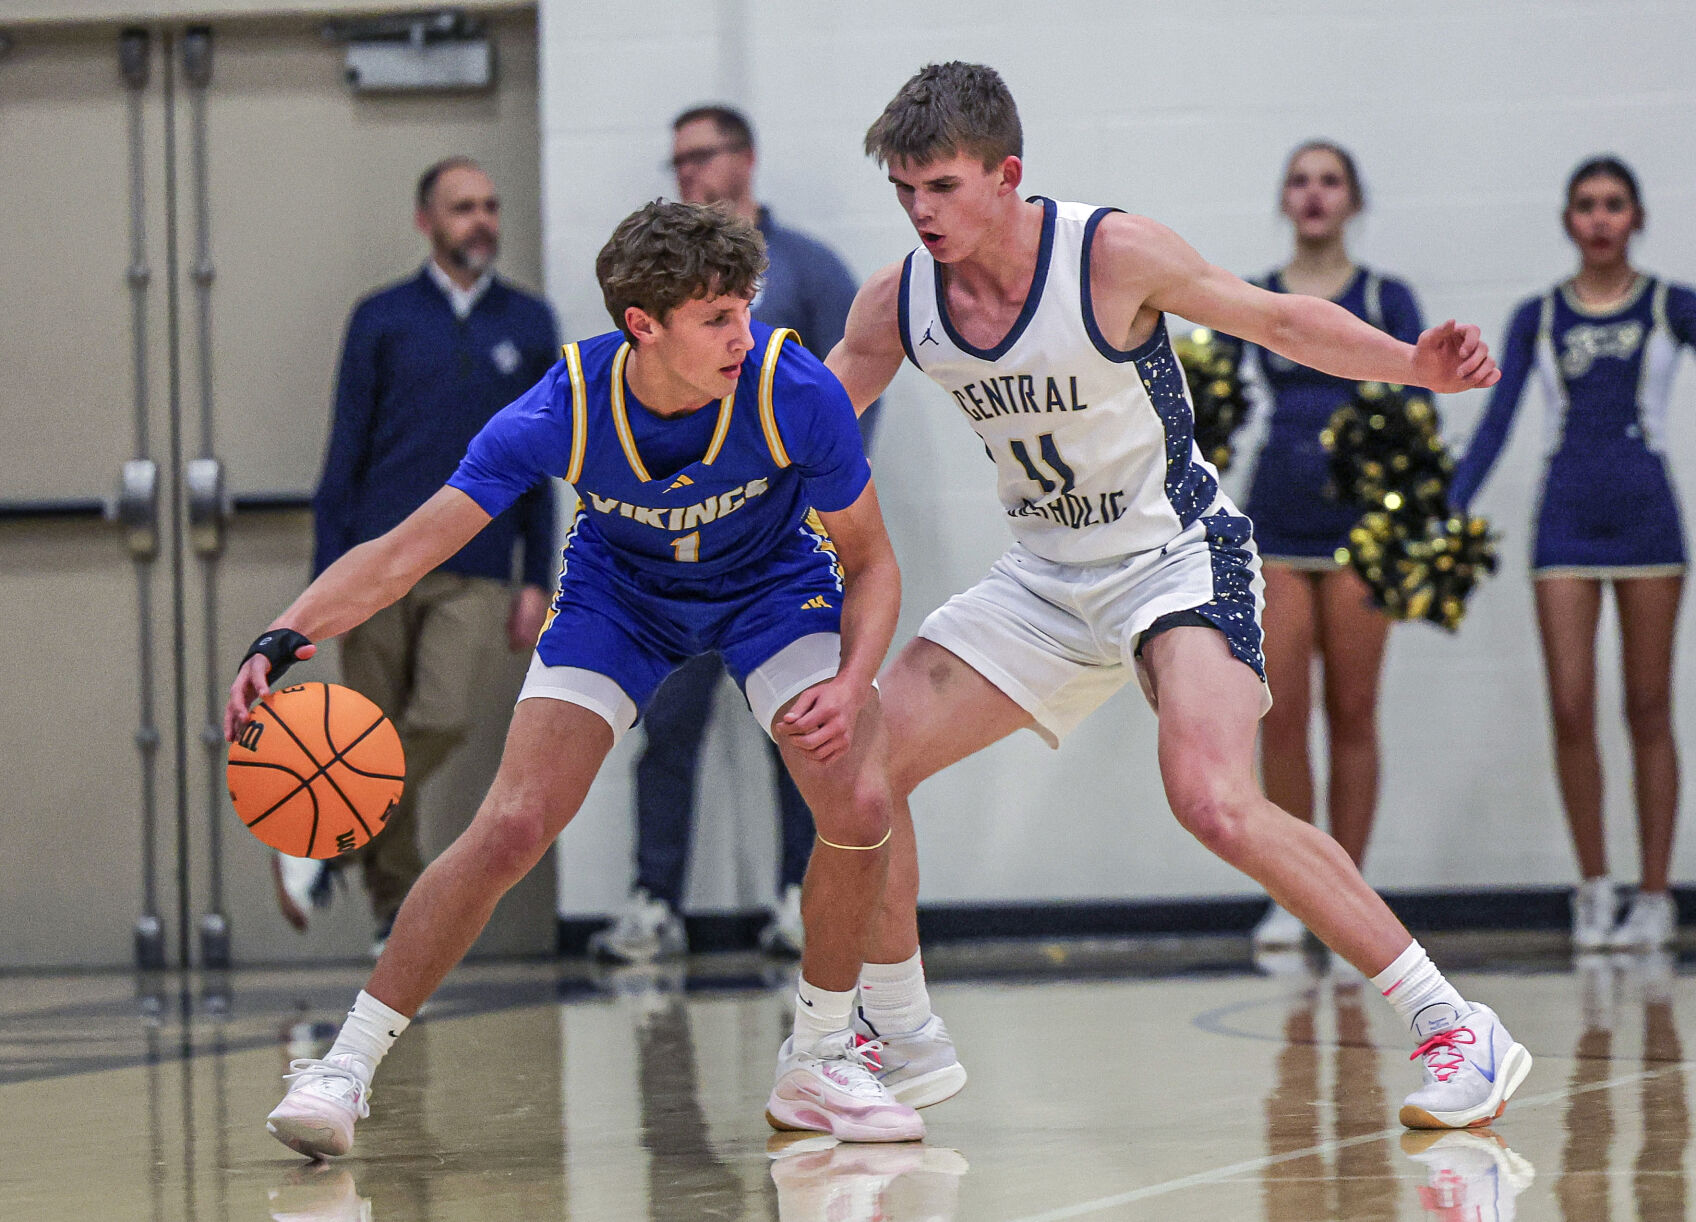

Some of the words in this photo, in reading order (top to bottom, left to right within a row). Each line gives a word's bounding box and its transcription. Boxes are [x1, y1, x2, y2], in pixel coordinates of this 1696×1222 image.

[952, 374, 1088, 421] CENTRAL
[1009, 431, 1075, 495] 11
[670, 531, 700, 562] 1
